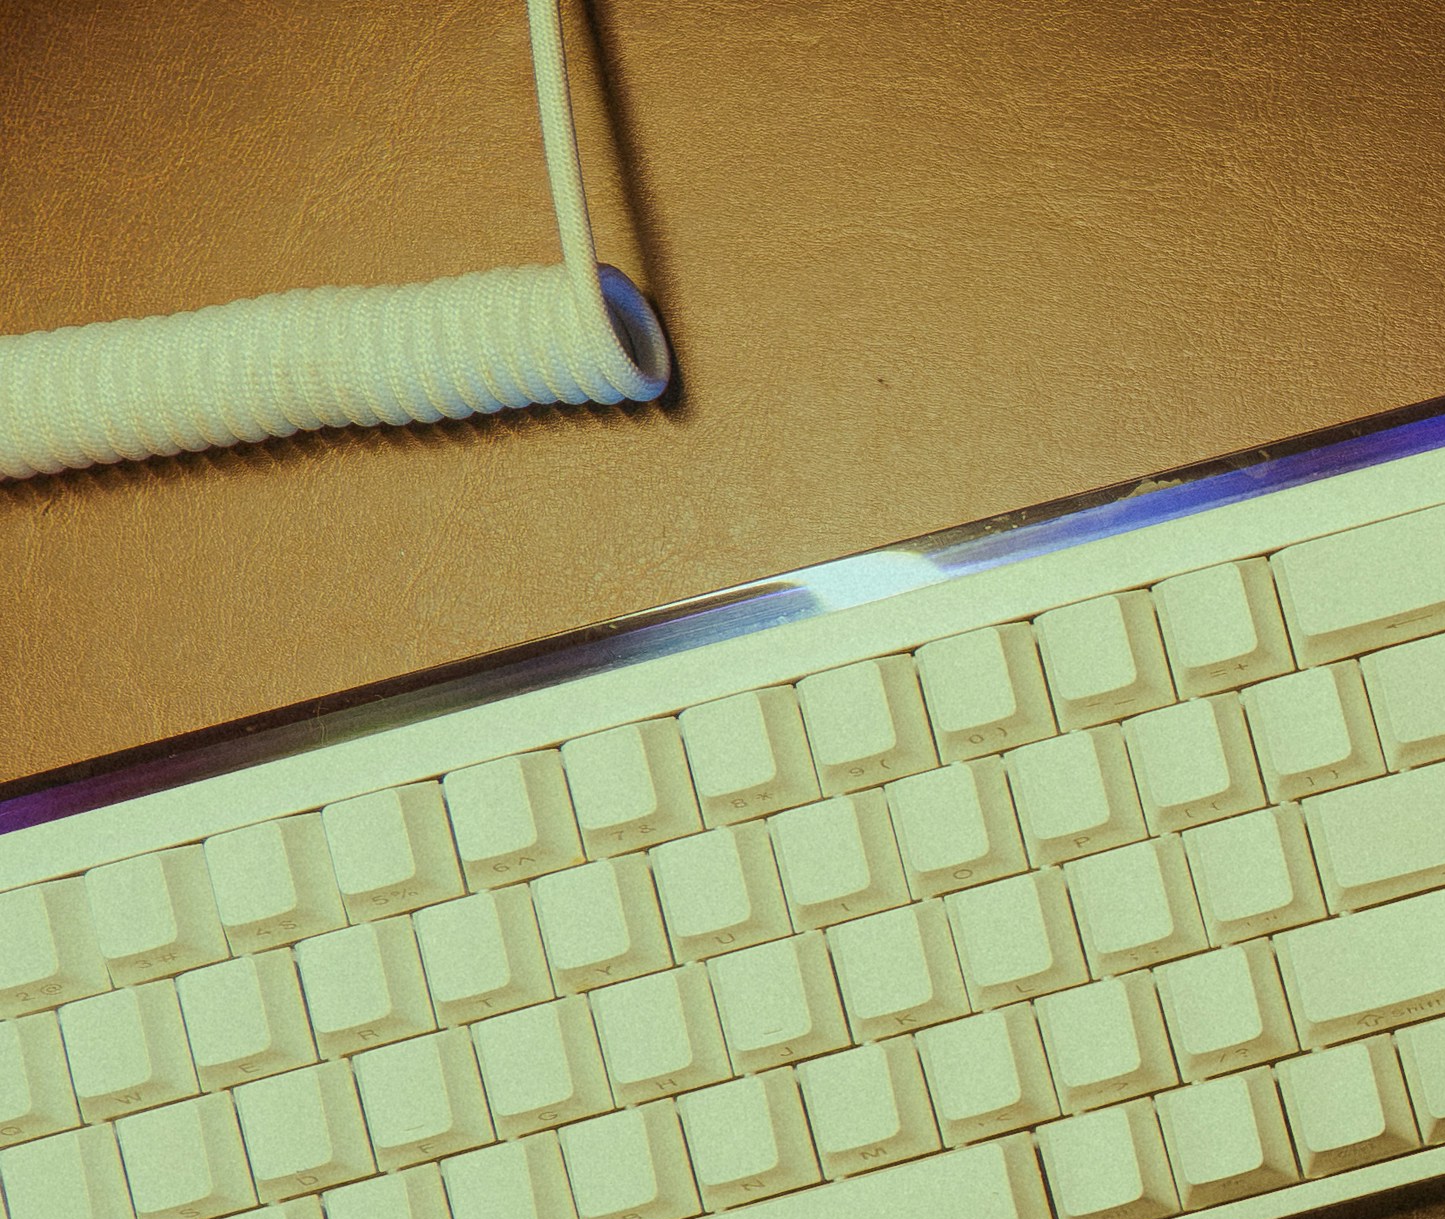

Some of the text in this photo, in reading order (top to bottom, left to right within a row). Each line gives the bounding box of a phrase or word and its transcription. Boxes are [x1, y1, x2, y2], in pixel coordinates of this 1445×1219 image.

[1074, 836, 1090, 849] P
[492, 862, 510, 874] 6
[372, 894, 390, 907] 5
[715, 932, 735, 945] U
[135, 958, 154, 970] 3
[596, 965, 614, 977] Y
[15, 982, 64, 1002] 2 @
[1016, 983, 1035, 995] L
[478, 998, 493, 1009] T
[895, 1013, 917, 1026] K
[358, 1028, 380, 1041] R
[780, 1045, 794, 1058] J
[239, 1062, 261, 1075] E
[655, 1078, 677, 1091] H
[115, 1091, 143, 1105] W
[538, 1110, 559, 1122] G
[417, 1142, 434, 1155] F
[858, 1146, 889, 1160] M
[296, 1173, 319, 1187] D
[741, 1178, 767, 1192] N
[179, 1207, 201, 1219] S
